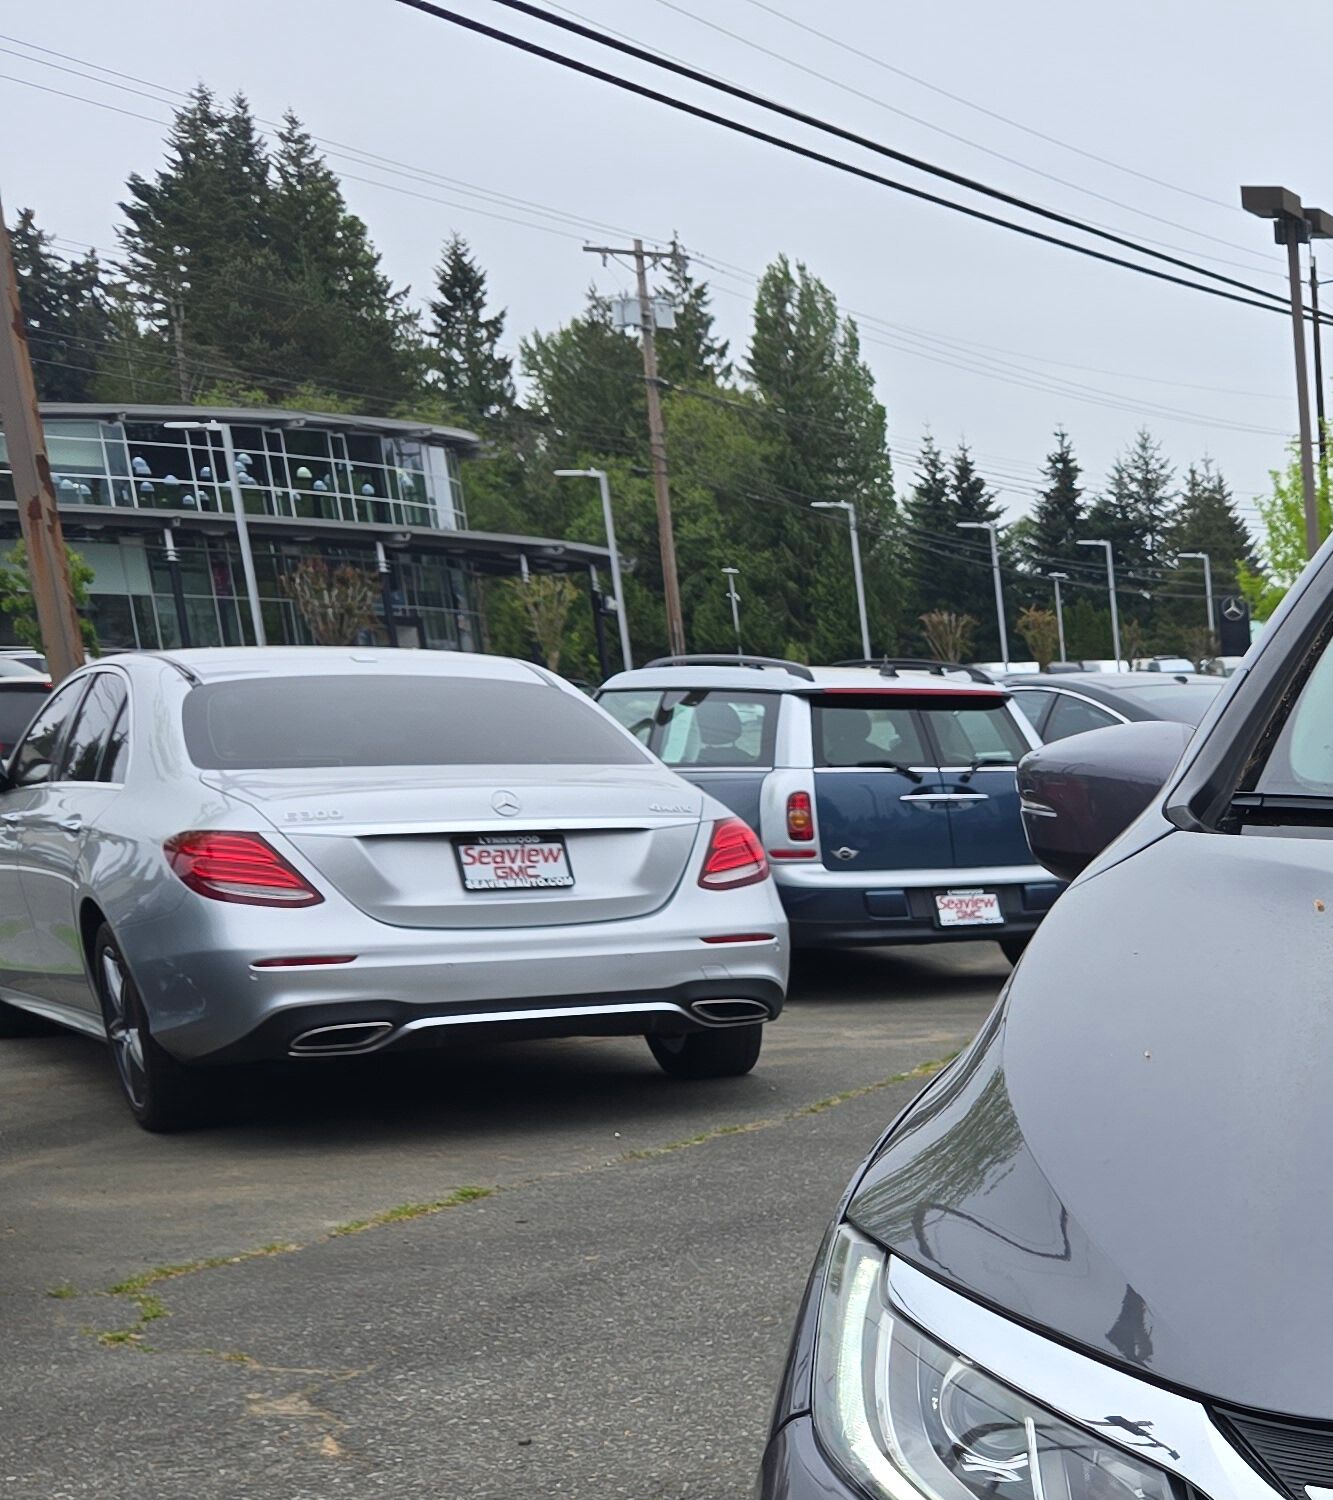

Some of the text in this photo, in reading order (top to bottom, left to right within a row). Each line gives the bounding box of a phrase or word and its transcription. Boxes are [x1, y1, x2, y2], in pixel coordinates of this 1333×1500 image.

[463, 845, 563, 865] Seaview
[494, 865, 541, 880] GMC
[940, 896, 995, 910] Seaview
